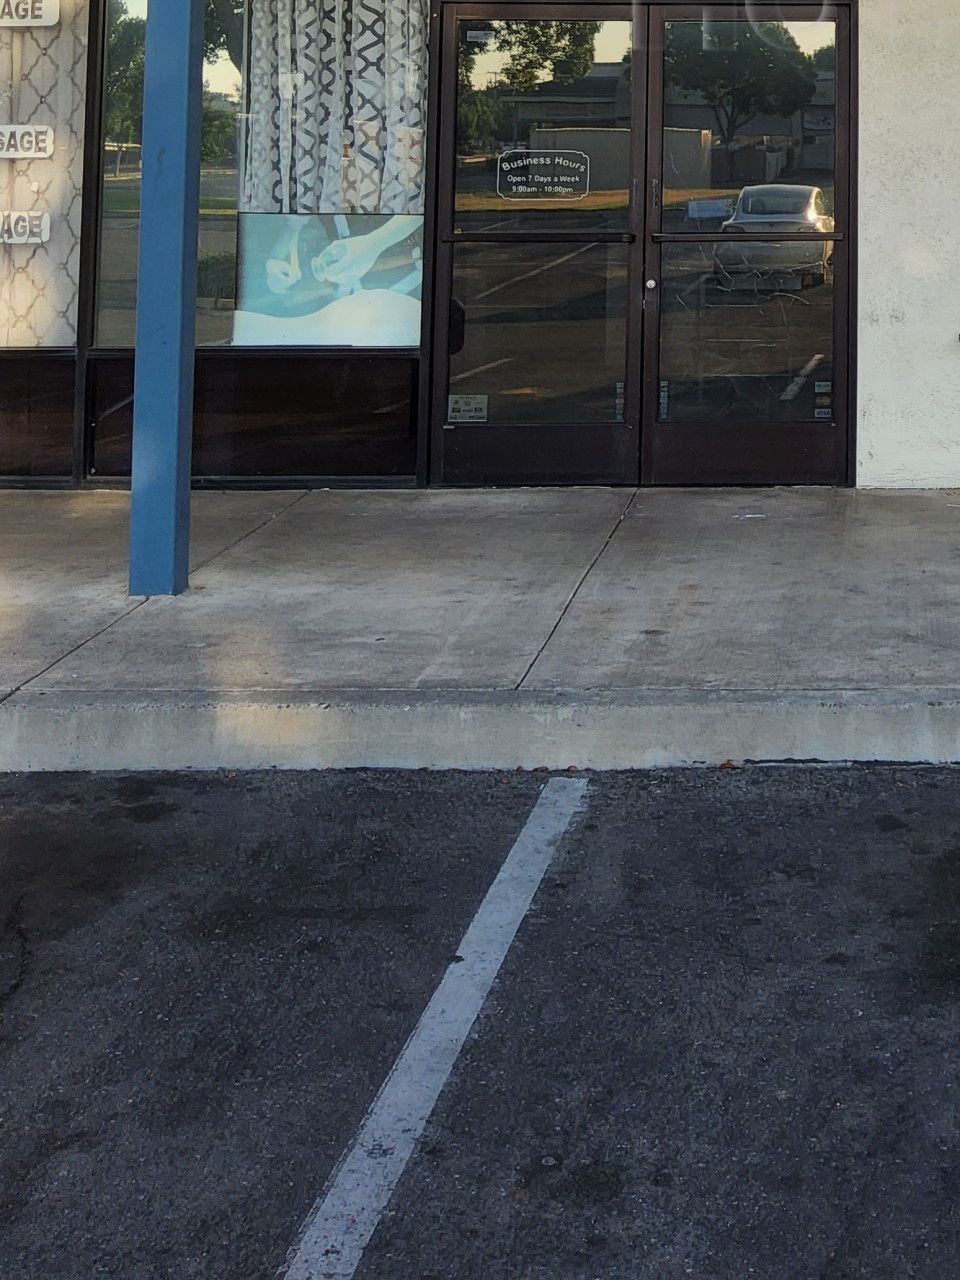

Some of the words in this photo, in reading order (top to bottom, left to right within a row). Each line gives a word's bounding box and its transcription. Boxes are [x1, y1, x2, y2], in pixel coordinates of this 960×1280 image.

[502, 157, 551, 171] Business
[554, 156, 586, 172] Hours
[507, 175, 526, 183] Open
[534, 175, 552, 183] Days
